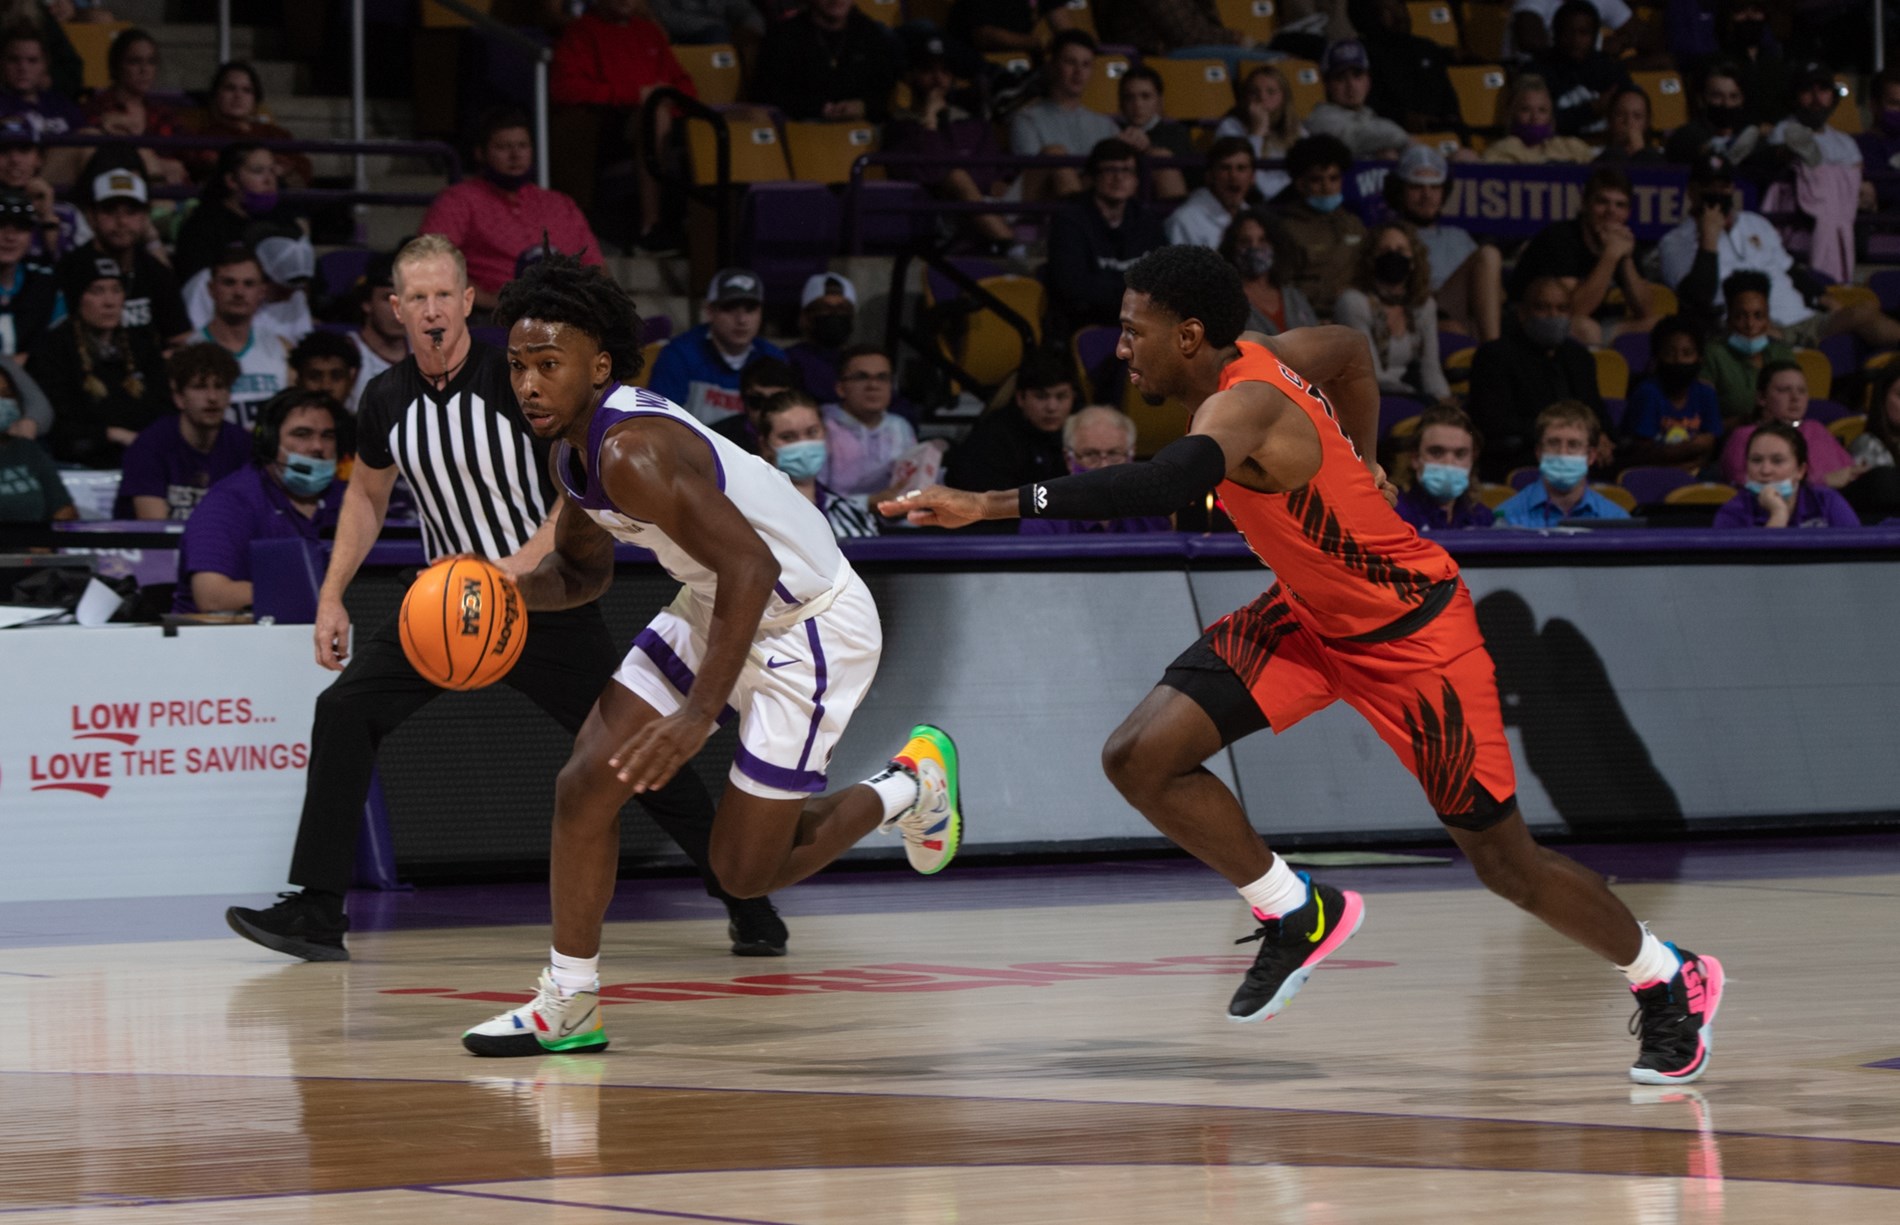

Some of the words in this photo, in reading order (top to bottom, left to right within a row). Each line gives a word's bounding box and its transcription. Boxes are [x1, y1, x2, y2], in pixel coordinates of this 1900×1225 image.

[461, 578, 482, 636] NCAA
[72, 703, 140, 731] LOW
[150, 698, 277, 728] PRICES...
[31, 752, 111, 781] LOVE
[121, 749, 176, 777] THE
[185, 743, 308, 775] SAVINGS
